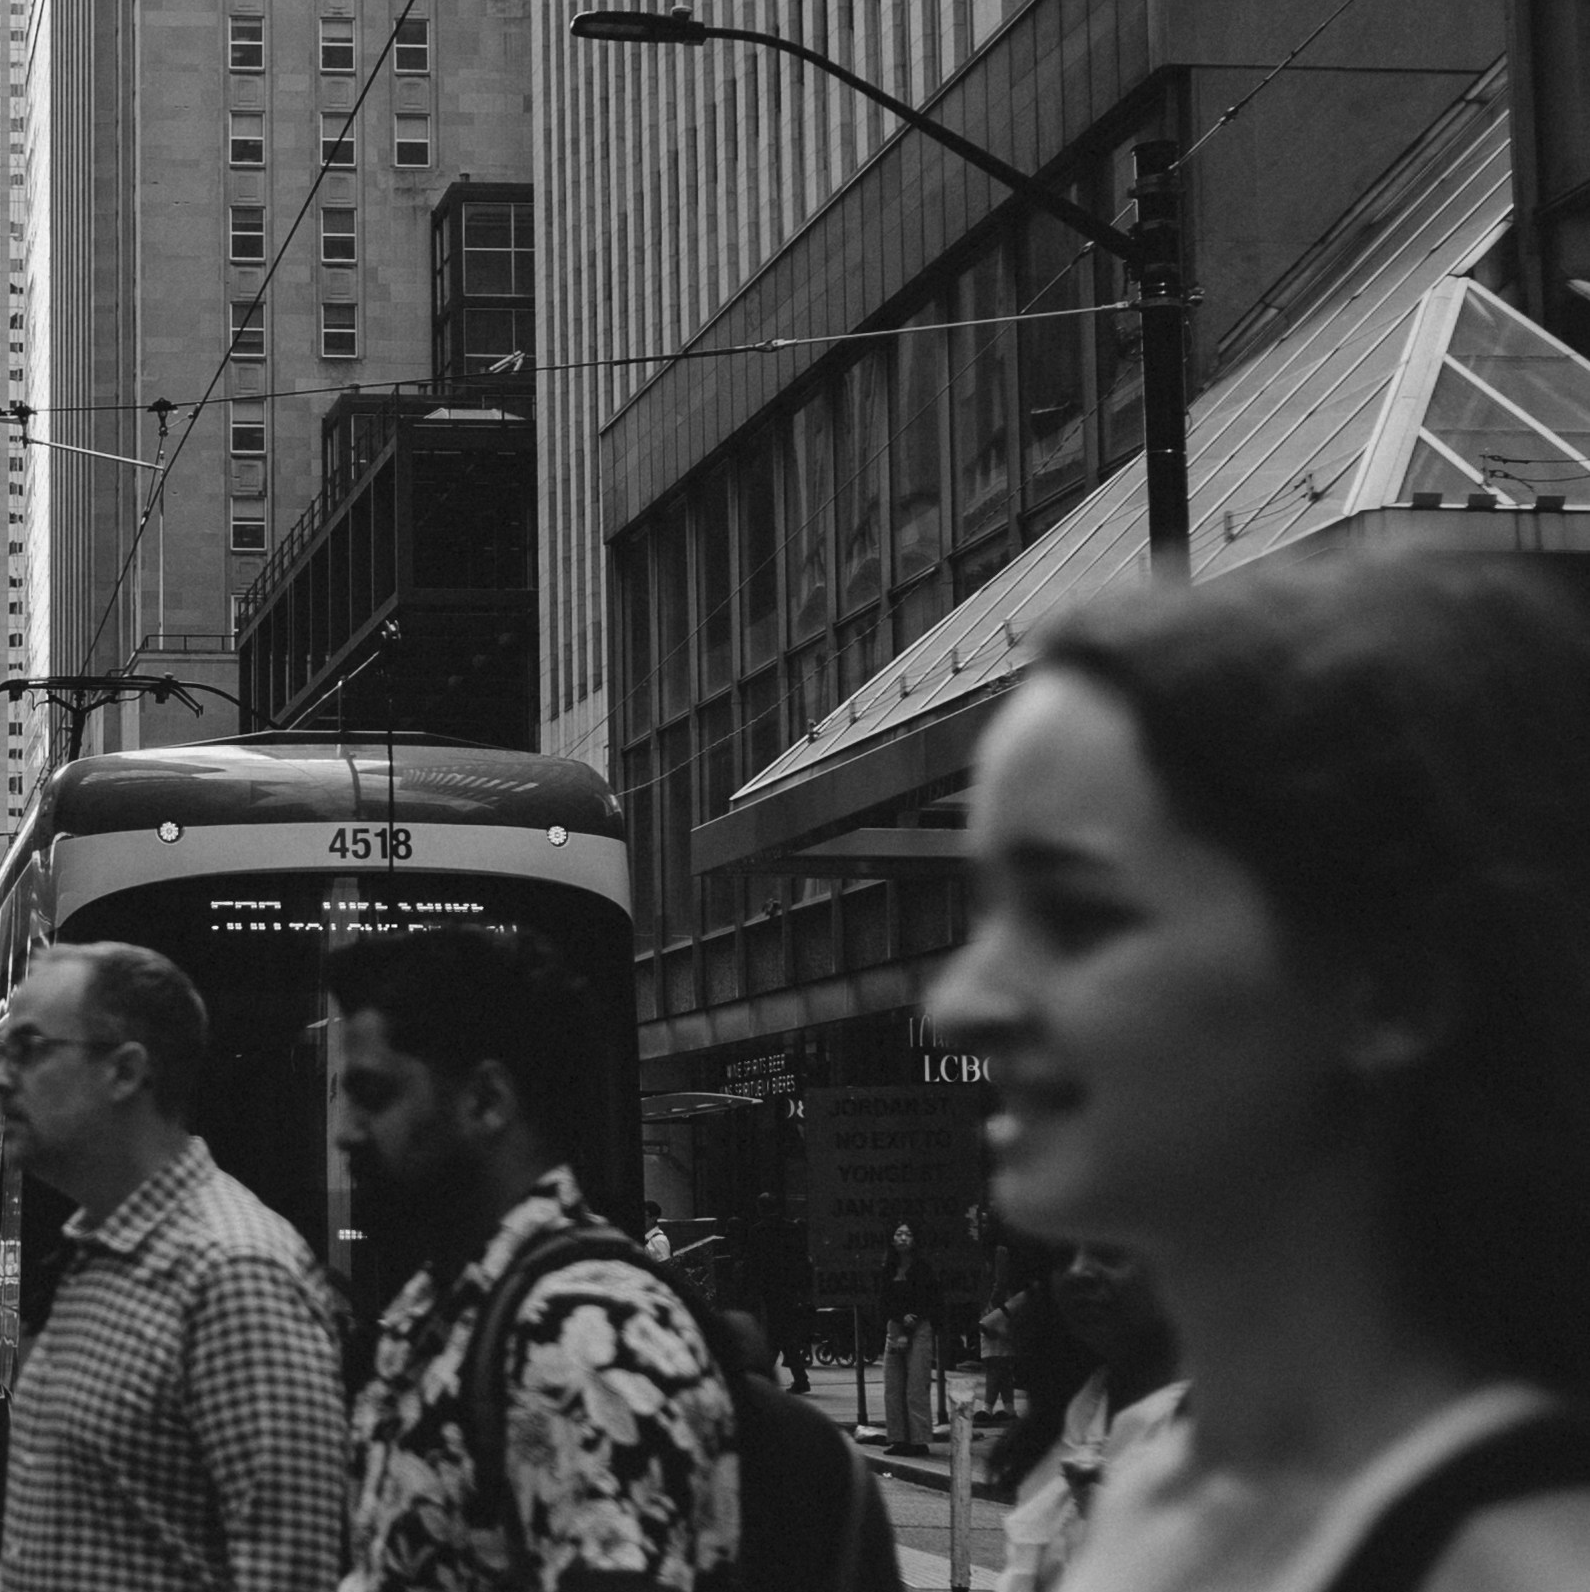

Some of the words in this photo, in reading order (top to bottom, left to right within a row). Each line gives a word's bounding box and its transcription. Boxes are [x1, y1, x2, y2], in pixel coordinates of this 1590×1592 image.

[328, 827, 413, 860] 4518
[743, 1057, 767, 1077] SPIRITS
[768, 1053, 785, 1073] BEER
[828, 1097, 919, 1117] JORDAN
[834, 1130, 867, 1150] NO
[872, 1130, 920, 1149] EXIT
[924, 1129, 952, 1149] TO
[837, 1164, 915, 1183] YONGE
[831, 1198, 874, 1218] JAN
[930, 1196, 959, 1216] TO
